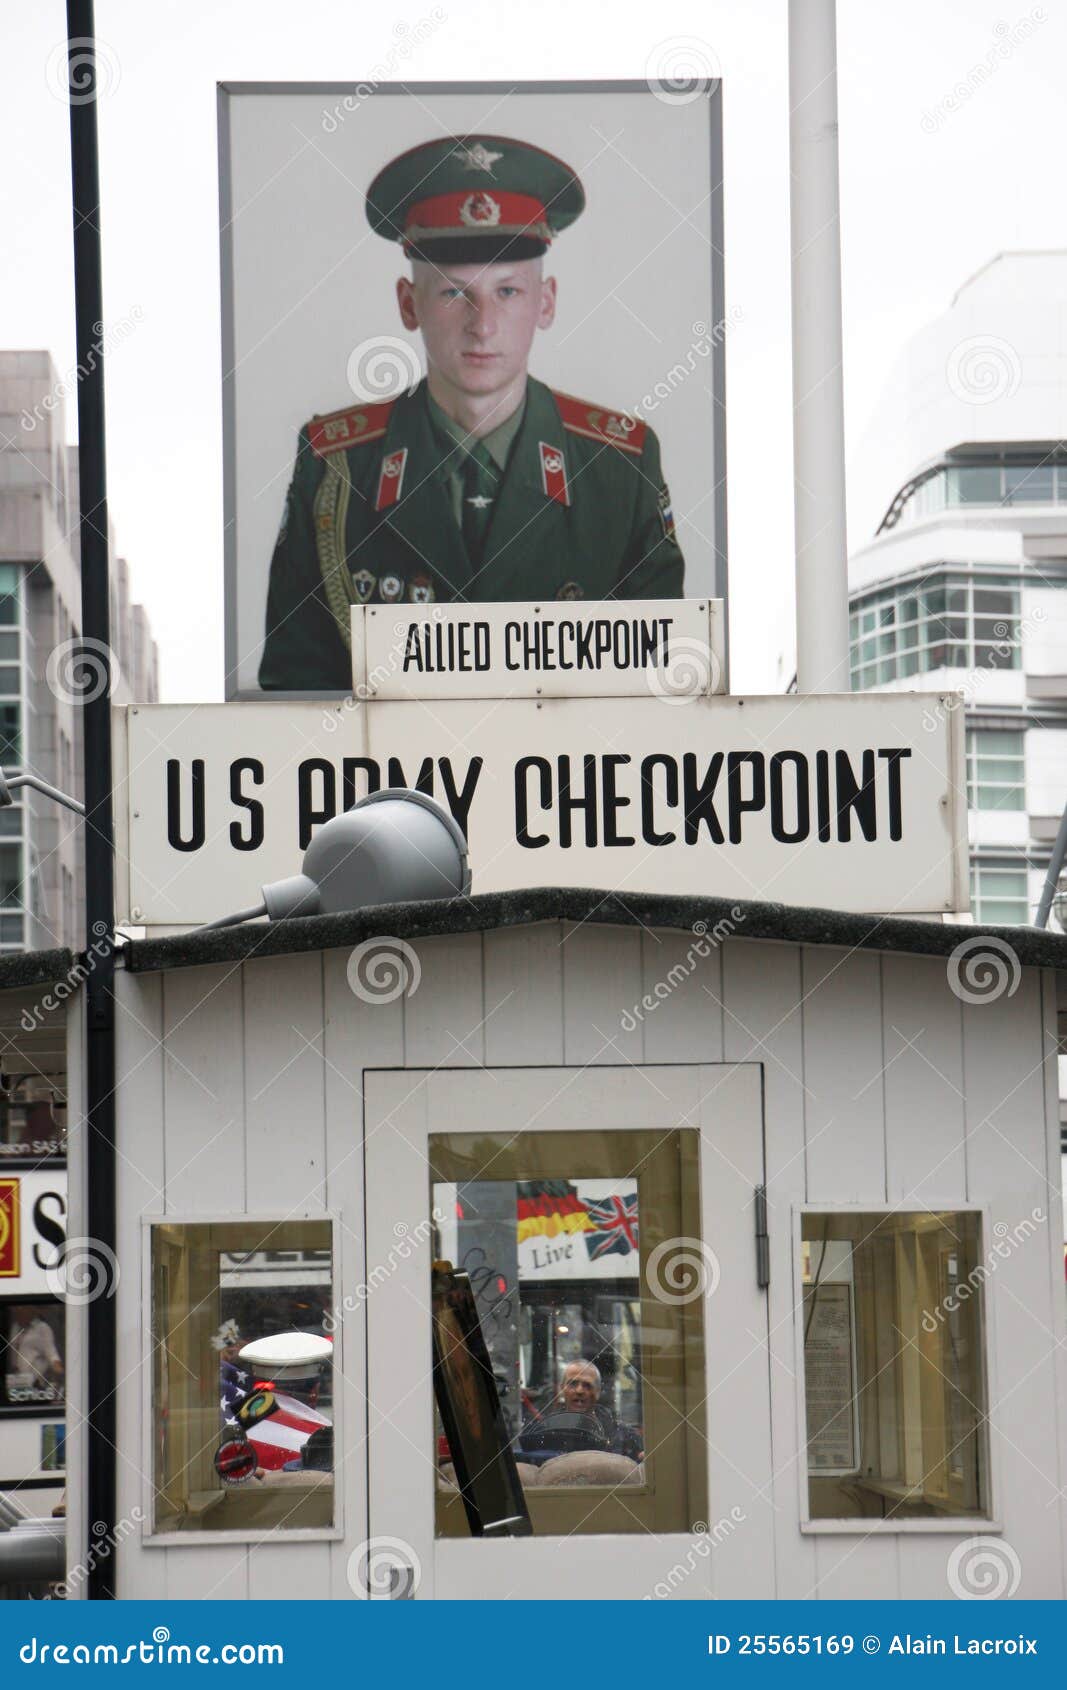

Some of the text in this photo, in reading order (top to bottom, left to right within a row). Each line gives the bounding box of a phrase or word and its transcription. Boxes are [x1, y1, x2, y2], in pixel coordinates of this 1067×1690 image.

[403, 618, 674, 673] ALLIED CHECKPOINT
[167, 758, 206, 853] U
[229, 757, 265, 852] S
[514, 748, 912, 849] CHECKPOINT
[532, 1244, 574, 1270] Live
